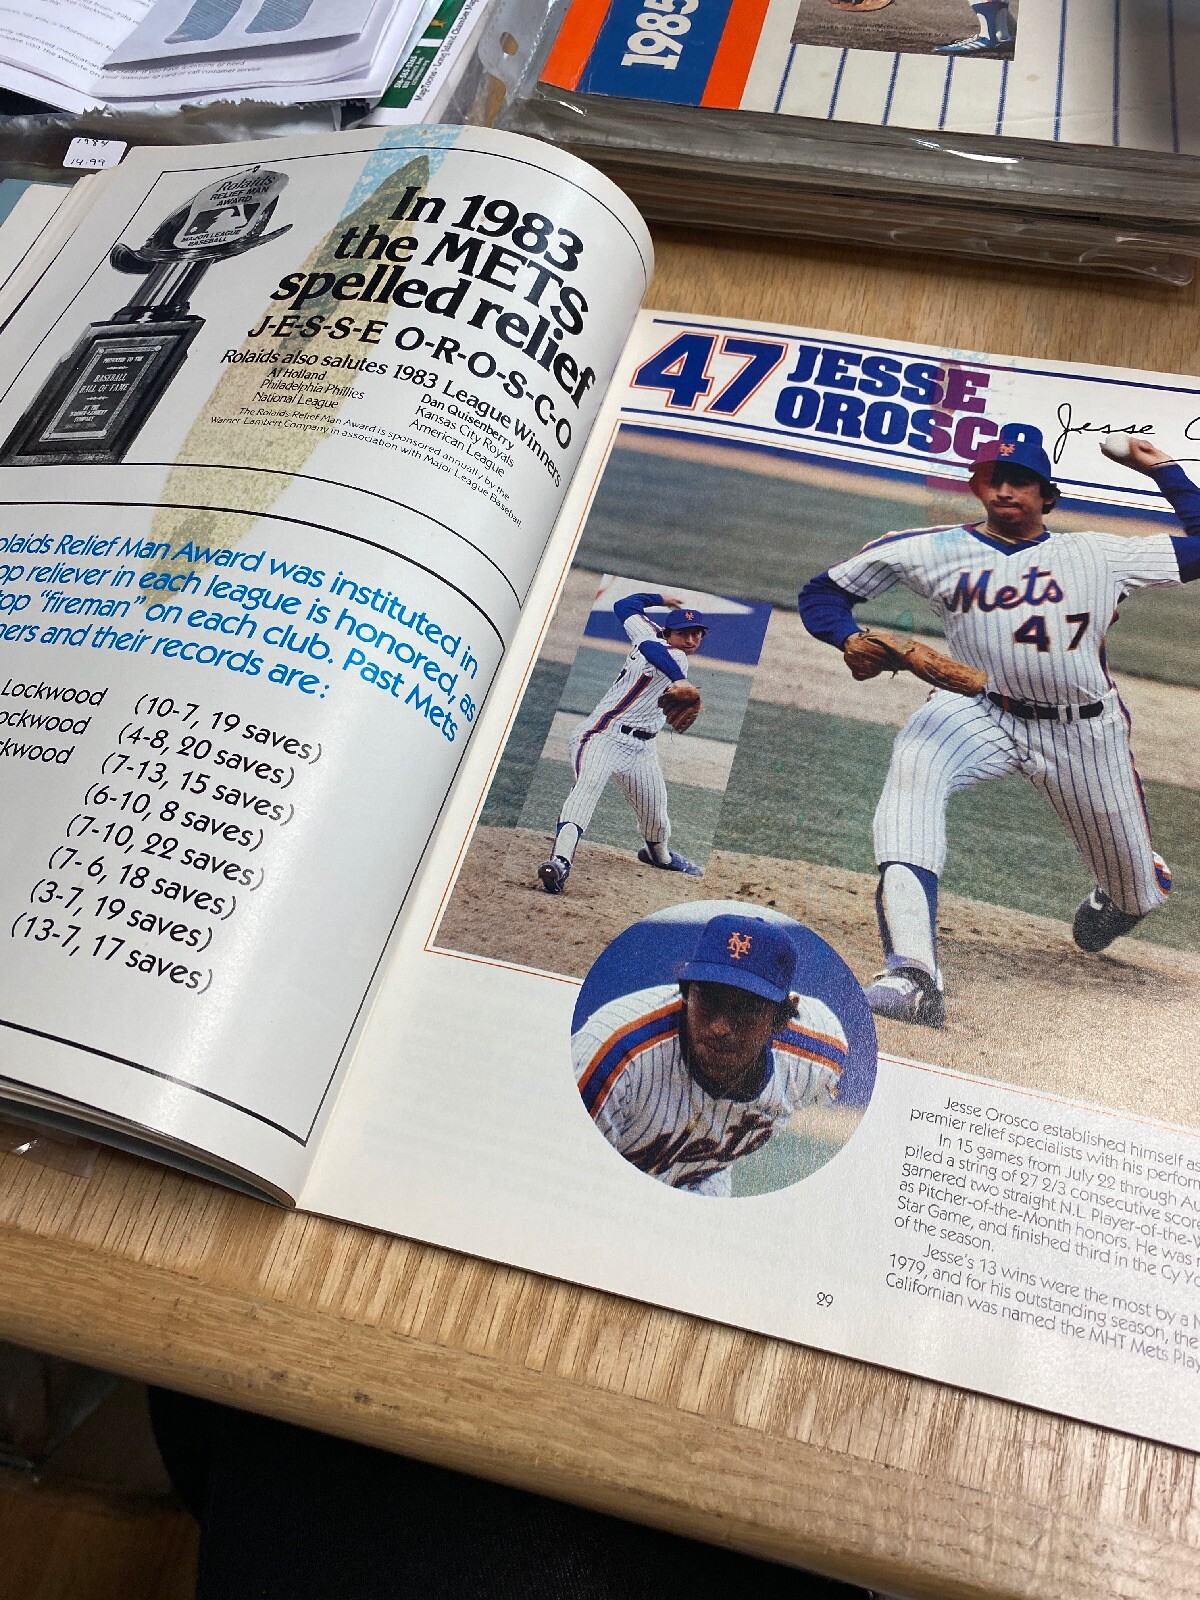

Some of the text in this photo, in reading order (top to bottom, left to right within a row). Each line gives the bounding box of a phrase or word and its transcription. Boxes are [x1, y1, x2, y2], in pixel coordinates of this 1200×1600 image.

[621, 0, 699, 70] 1985
[210, 185, 271, 201] RELIEF MAN
[216, 195, 254, 207] AWARD
[181, 229, 242, 243] MAJOR LEAGUE
[188, 236, 228, 247] BASEBALL
[388, 186, 584, 272] In 1983
[333, 224, 590, 336] the METS
[270, 264, 597, 409] spelled relief
[247, 315, 572, 450] J-E-S-S-E O-R-O-S-C-O
[252, 391, 339, 410] National League
[260, 378, 366, 400] Philadelphia Phillies
[267, 367, 327, 381] Al Holland
[629, 331, 788, 416] 47
[787, 345, 989, 413] JESSE
[220, 349, 562, 488] Rolaids also salutes 1983 League Winners
[284, 420, 329, 434] Company
[341, 431, 399, 450] association
[400, 446, 422, 460] with
[423, 454, 454, 474] Major
[343, 418, 377, 433] Award
[388, 432, 442, 457] sponsored
[409, 419, 505, 477] American League
[415, 406, 515, 468] Kansas City Royals
[421, 393, 515, 451] Dan Quisenberry
[1053, 403, 1155, 464] Jesse
[54, 534, 122, 558] Relief
[119, 538, 171, 560] Man
[170, 541, 266, 572] Award
[270, 558, 326, 588] was
[329, 571, 462, 659] instituted
[460, 646, 478, 679] in
[945, 566, 1064, 613] Mets
[25, 562, 112, 586] reliever
[110, 565, 135, 588] in
[138, 571, 201, 595] each
[203, 575, 302, 615] league
[306, 598, 331, 624] is
[335, 608, 459, 704] honored,
[460, 694, 476, 723] as
[40, 623, 93, 647] and
[91, 626, 153, 653] their
[150, 634, 265, 676] records
[268, 663, 330, 699] are:
[1012, 612, 1090, 653] 47
[1, 679, 109, 707] Lockwood
[145, 603, 183, 624] on
[187, 612, 258, 639] each
[263, 624, 334, 664] club.
[342, 647, 405, 698] Past
[404, 683, 459, 743] Mets
[118, 722, 295, 789] (4-8, 20 saves)
[134, 693, 322, 765] (10-7, 19 saves)
[84, 782, 264, 852] (6-10, 8 saves)
[101, 751, 295, 827] (7-13, 15 saves)
[66, 813, 265, 892] (7-10, 22 saves)
[30, 879, 213, 953] (3-7, 19 saves)
[118, 863, 150, 889] 18
[151, 876, 236, 921] saves)
[11, 911, 214, 995] (13-7, 17 saves)
[910, 1108, 1083, 1161] premier relief specialists
[943, 1097, 1184, 1167] Jesse Orosco established himself
[901, 1162, 1056, 1211] garnered straight
[904, 1144, 944, 1164] piled
[958, 1158, 997, 1181] string
[1070, 1187, 1161, 1220] consecutive
[977, 1146, 1023, 1167] games
[1028, 1155, 1061, 1176] from
[1065, 1165, 1094, 1187] July
[1097, 1173, 1116, 1190] 22
[1120, 1179, 1177, 1206] through
[897, 1195, 1111, 1264] Star Game, finished third
[918, 1182, 1131, 1250] Pitcher-of-the-Month honors.
[939, 1228, 994, 1252] season.
[816, 1292, 834, 1308] 29
[885, 1272, 1169, 1362] Californian named MHT Mets
[889, 1253, 928, 1280] 1979,
[1015, 1291, 1107, 1327] outstanding
[1111, 1315, 1169, 1345] season,
[1001, 1266, 1037, 1286] wins
[1040, 1276, 1080, 1298] were
[1112, 1296, 1152, 1316] most
